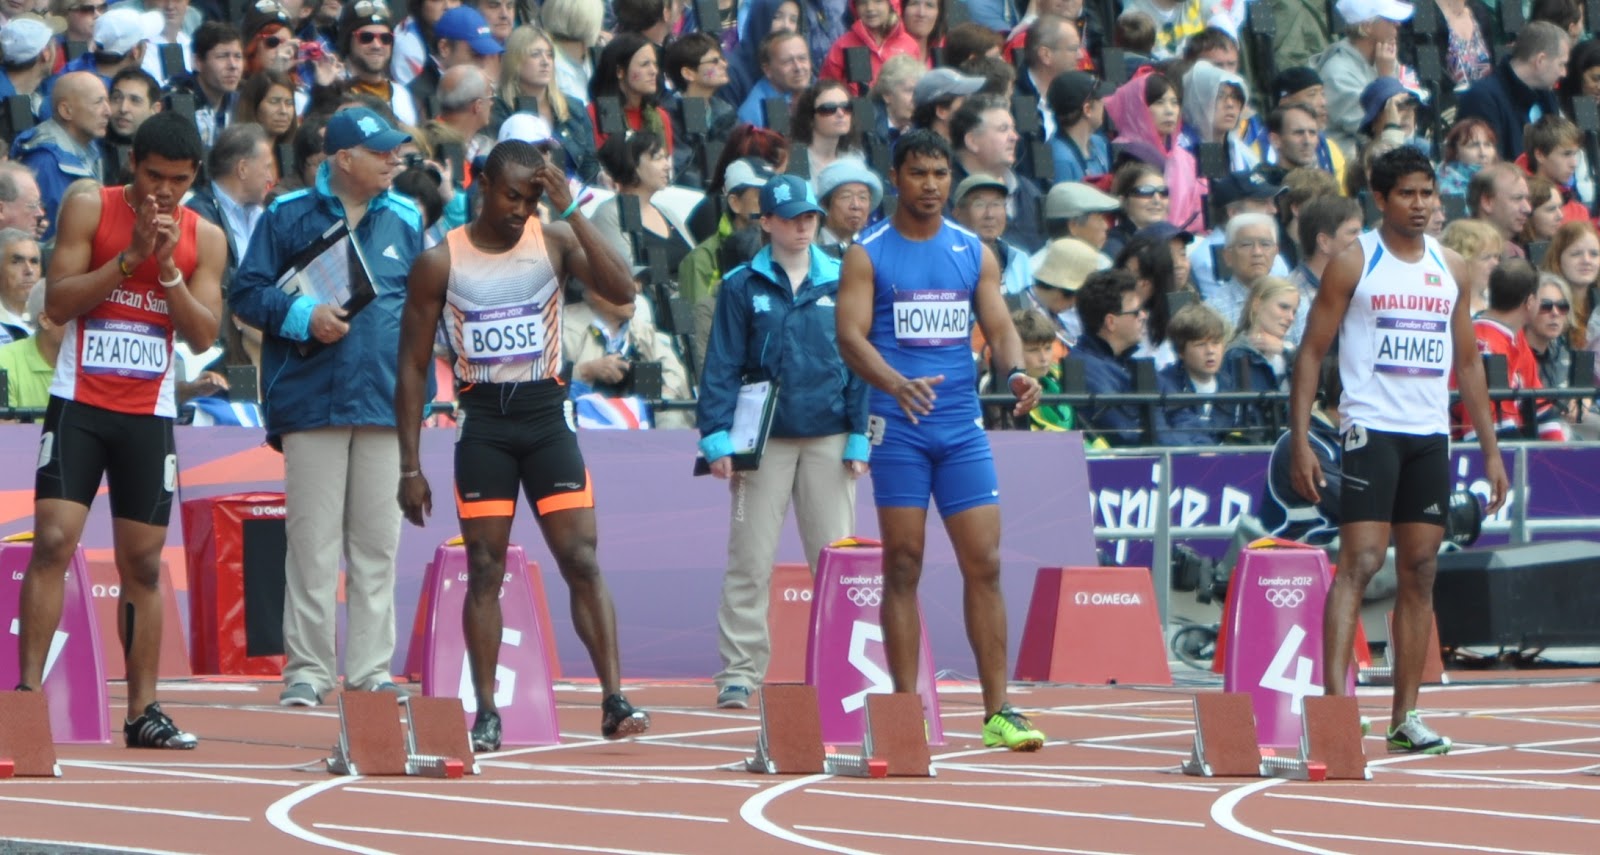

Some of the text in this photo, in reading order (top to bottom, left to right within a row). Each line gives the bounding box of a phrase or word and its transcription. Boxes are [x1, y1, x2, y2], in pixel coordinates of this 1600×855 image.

[110, 288, 168, 314] rican Sam
[912, 292, 957, 300] London 2012
[1370, 294, 1450, 315] MALDIVES
[480, 308, 523, 320] London 2012
[897, 308, 967, 333] HOWARD
[104, 322, 149, 333] London 2012
[1395, 320, 1437, 330] London 2012
[472, 322, 537, 353] BOSSE
[1378, 334, 1444, 363] AHMED
[840, 575, 872, 584] London
[1258, 576, 1312, 586] London 2012
[1091, 593, 1141, 605] OMEGA
[841, 620, 894, 714] 5
[1259, 624, 1325, 715] 4
